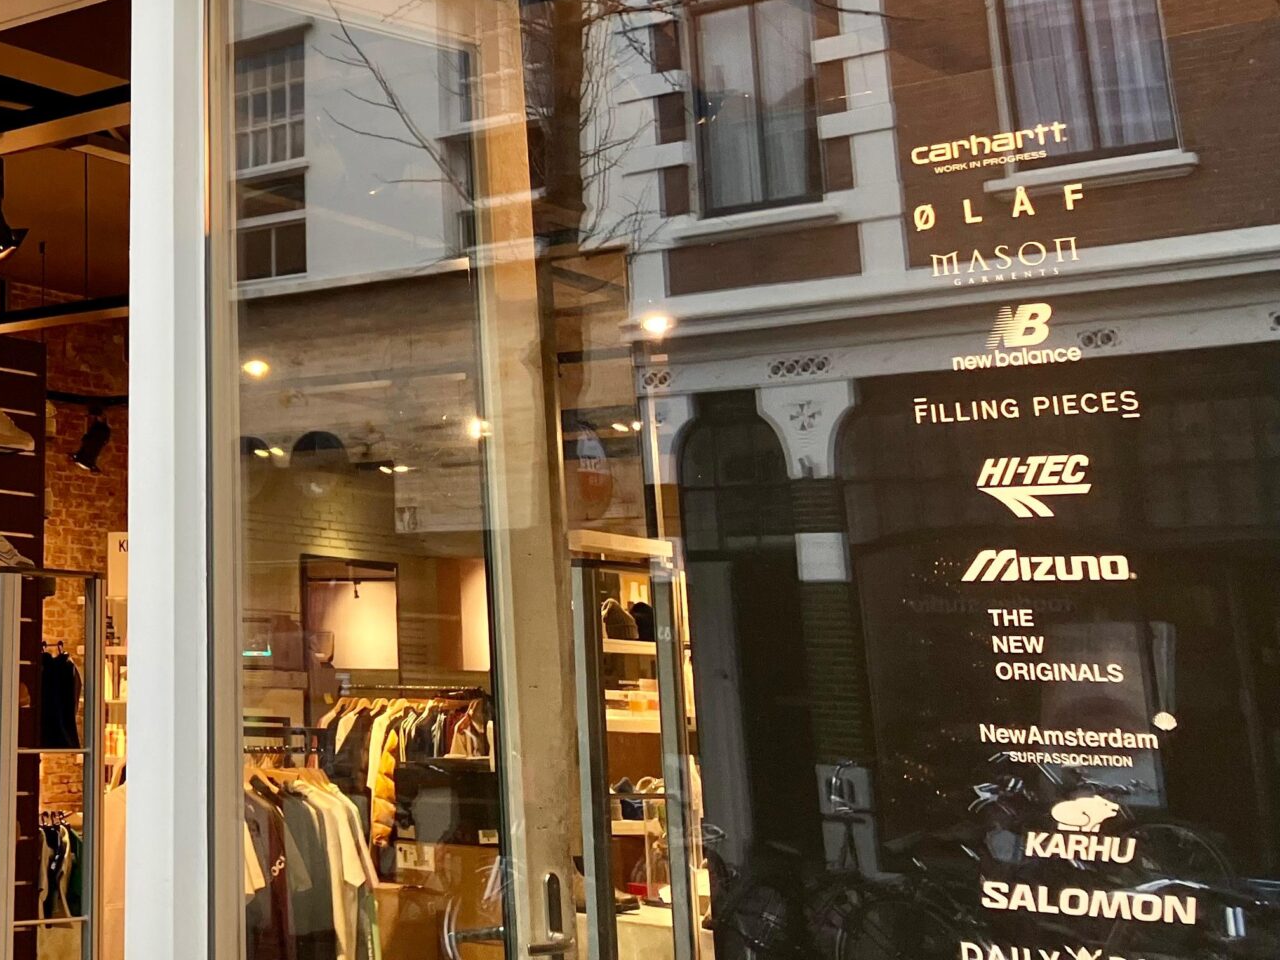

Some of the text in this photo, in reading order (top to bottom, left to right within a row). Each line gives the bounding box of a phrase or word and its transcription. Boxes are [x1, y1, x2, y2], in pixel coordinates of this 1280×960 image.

[911, 121, 1067, 165] carhartt
[934, 150, 1047, 174] WORK IN PROGRESS
[954, 267, 1059, 286] GARMENTS
[913, 390, 1141, 424] FILLING PIECES
[976, 454, 1090, 486] HI-TEC
[961, 549, 1130, 581] MIZUNO
[987, 609, 1035, 628] THE
[991, 635, 1044, 654] NEW
[995, 662, 1124, 683] ORIGINALS
[979, 724, 1159, 749] NewAmsterdam
[1009, 751, 1133, 768] SURFASSOCIATION
[1024, 832, 1136, 864] KARHU
[981, 881, 1197, 925] SALOMON
